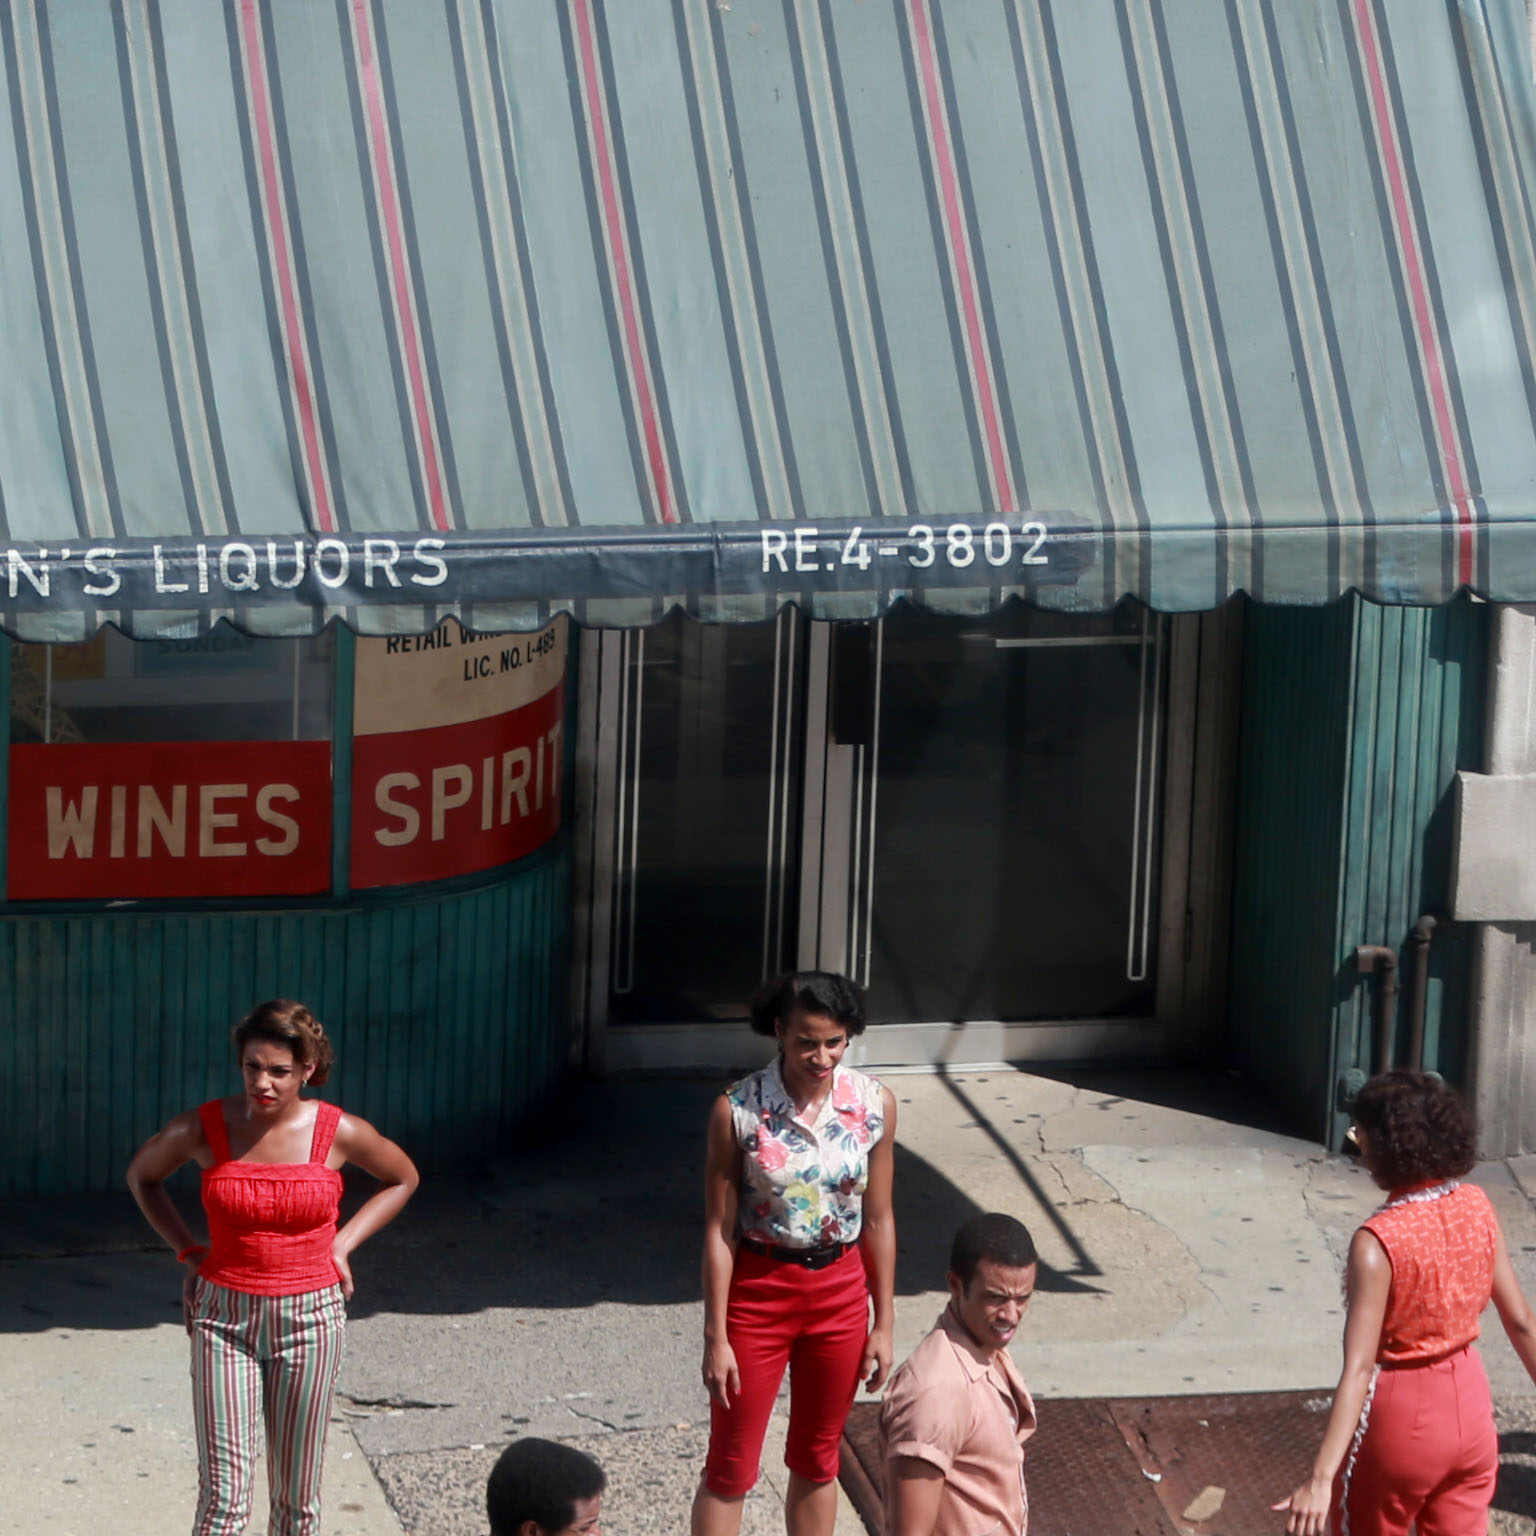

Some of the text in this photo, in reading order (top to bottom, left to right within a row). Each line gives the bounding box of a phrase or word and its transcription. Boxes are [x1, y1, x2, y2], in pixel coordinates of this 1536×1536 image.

[152, 537, 451, 595] LIQUORS
[386, 626, 452, 654] RETAIL
[463, 656, 495, 681] LIC.
[500, 647, 522, 673] NO.
[45, 783, 301, 860] WINES
